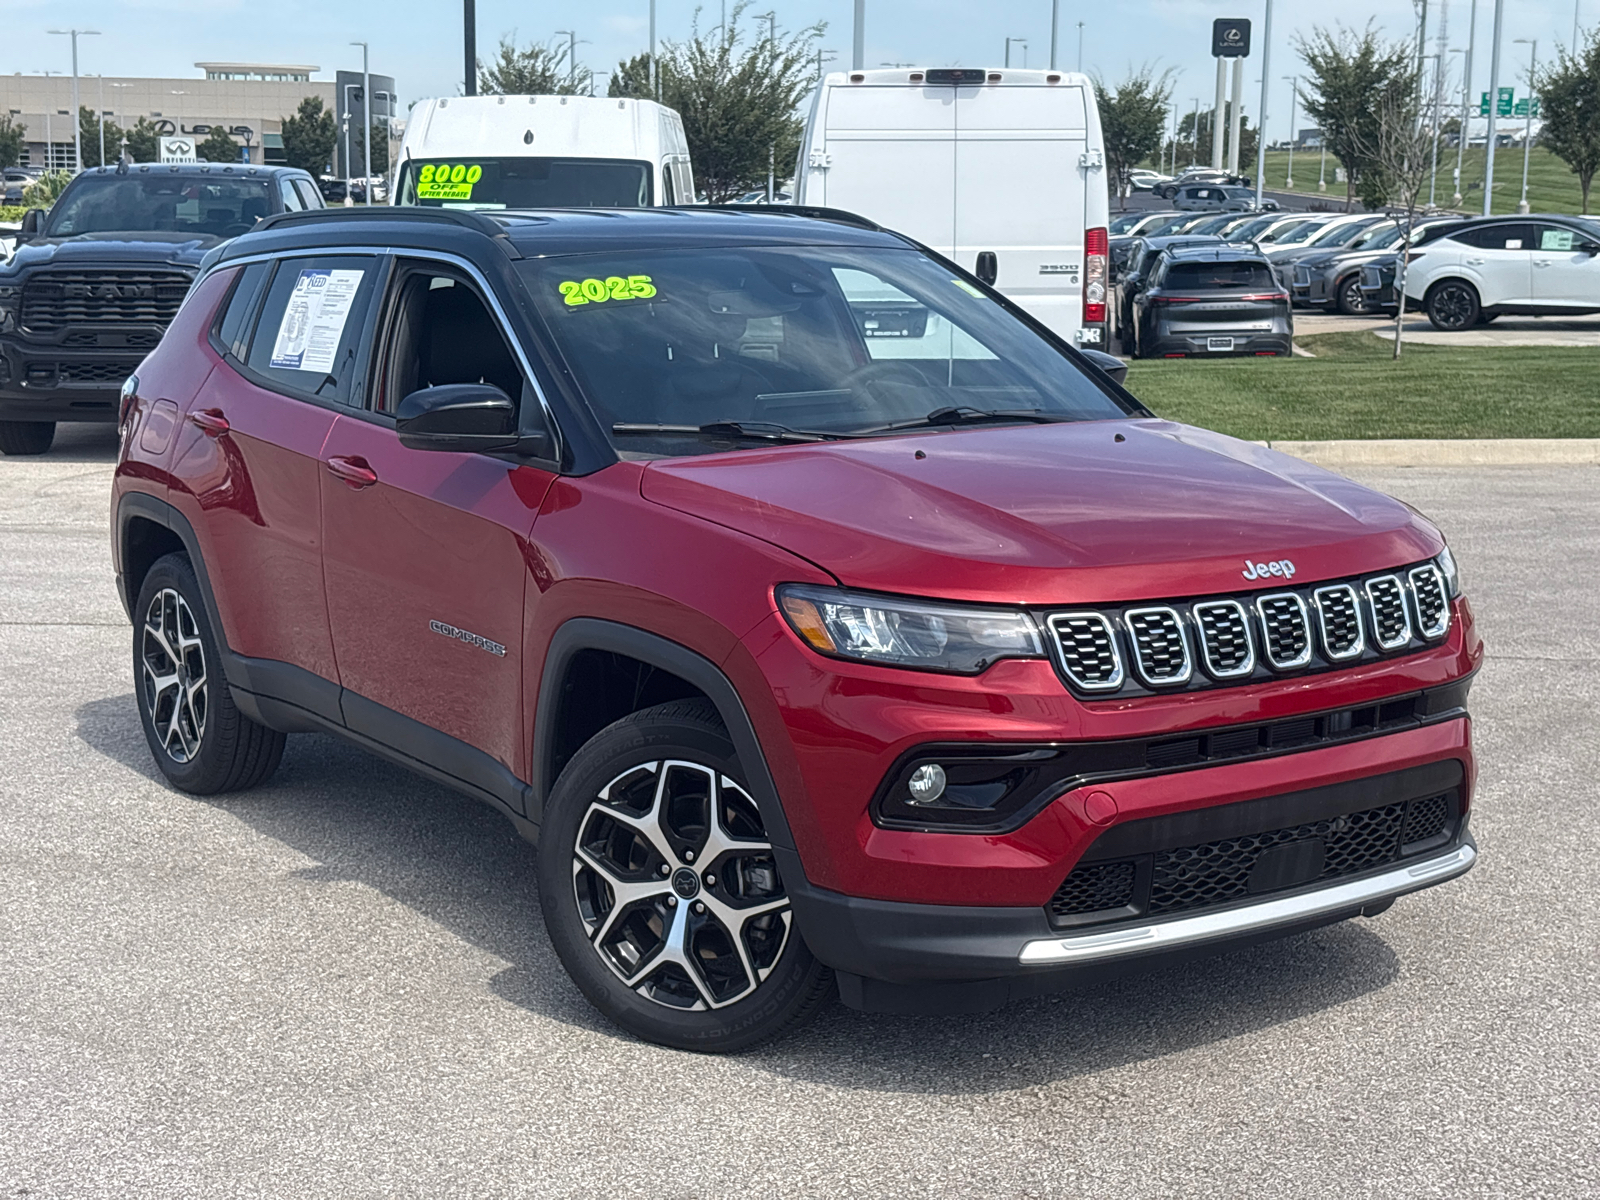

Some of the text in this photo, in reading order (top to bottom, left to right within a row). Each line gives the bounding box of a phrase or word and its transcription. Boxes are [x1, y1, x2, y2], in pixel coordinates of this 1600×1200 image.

[181, 124, 253, 136] LES
[419, 164, 482, 184] 8000
[64, 284, 156, 298] RAM
[559, 275, 657, 306] 2025
[1241, 559, 1296, 580] Jeep
[429, 619, 506, 658] COMPASS
